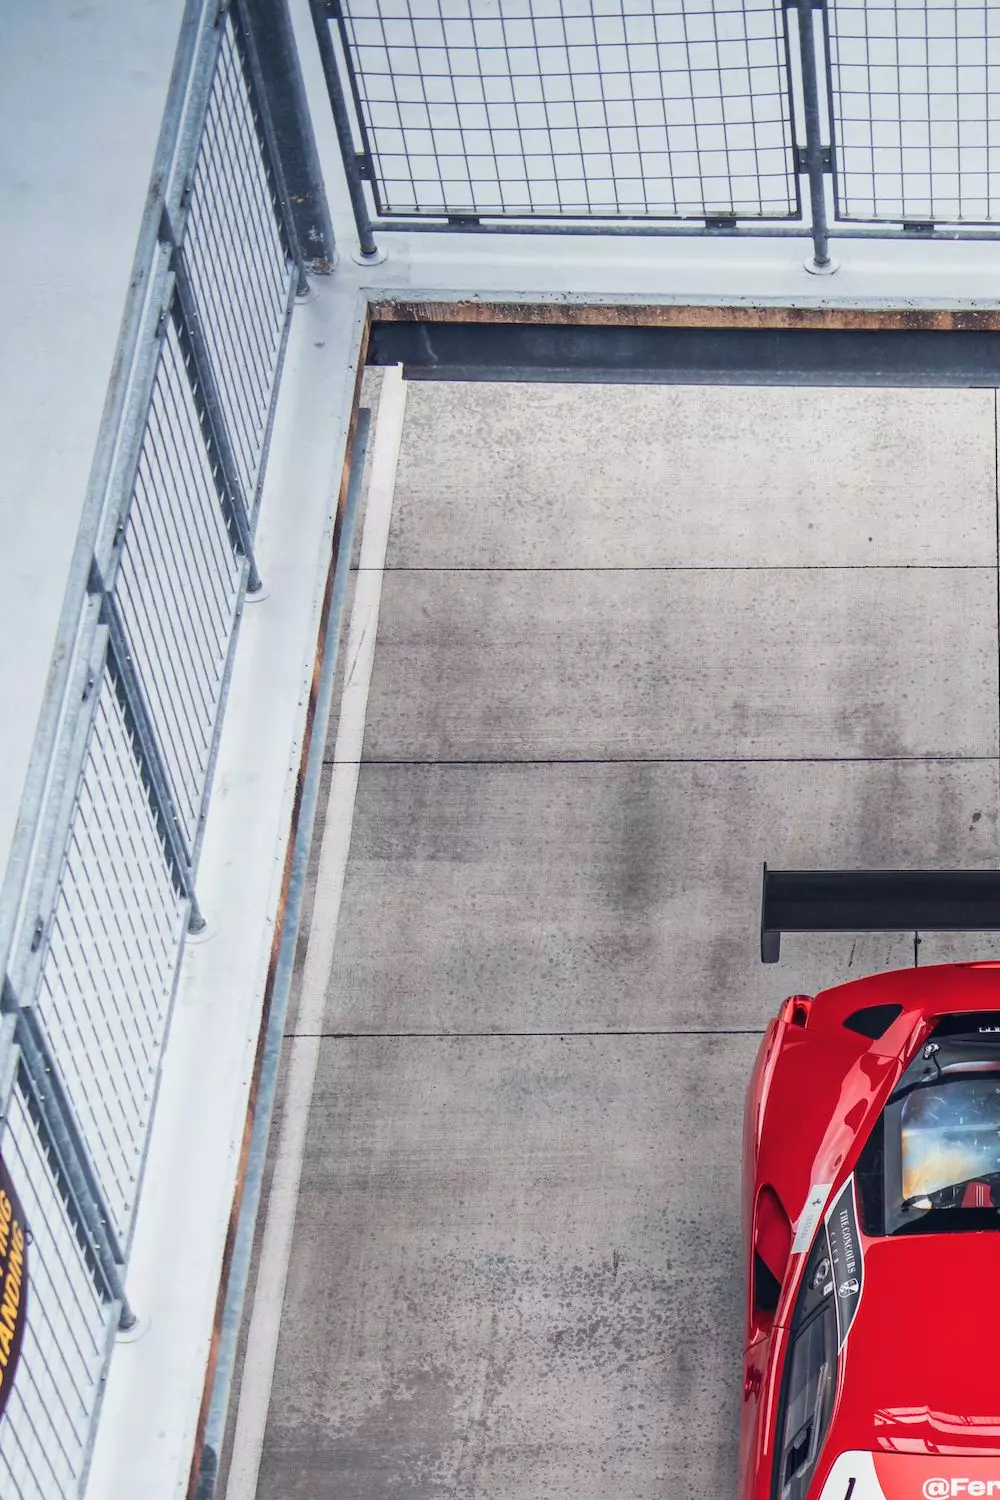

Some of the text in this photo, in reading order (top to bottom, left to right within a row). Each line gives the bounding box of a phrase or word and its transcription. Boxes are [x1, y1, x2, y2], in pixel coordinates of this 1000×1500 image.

[839, 1209, 857, 1274] THE CONCOURS
[0, 1219, 24, 1388] ANDING
